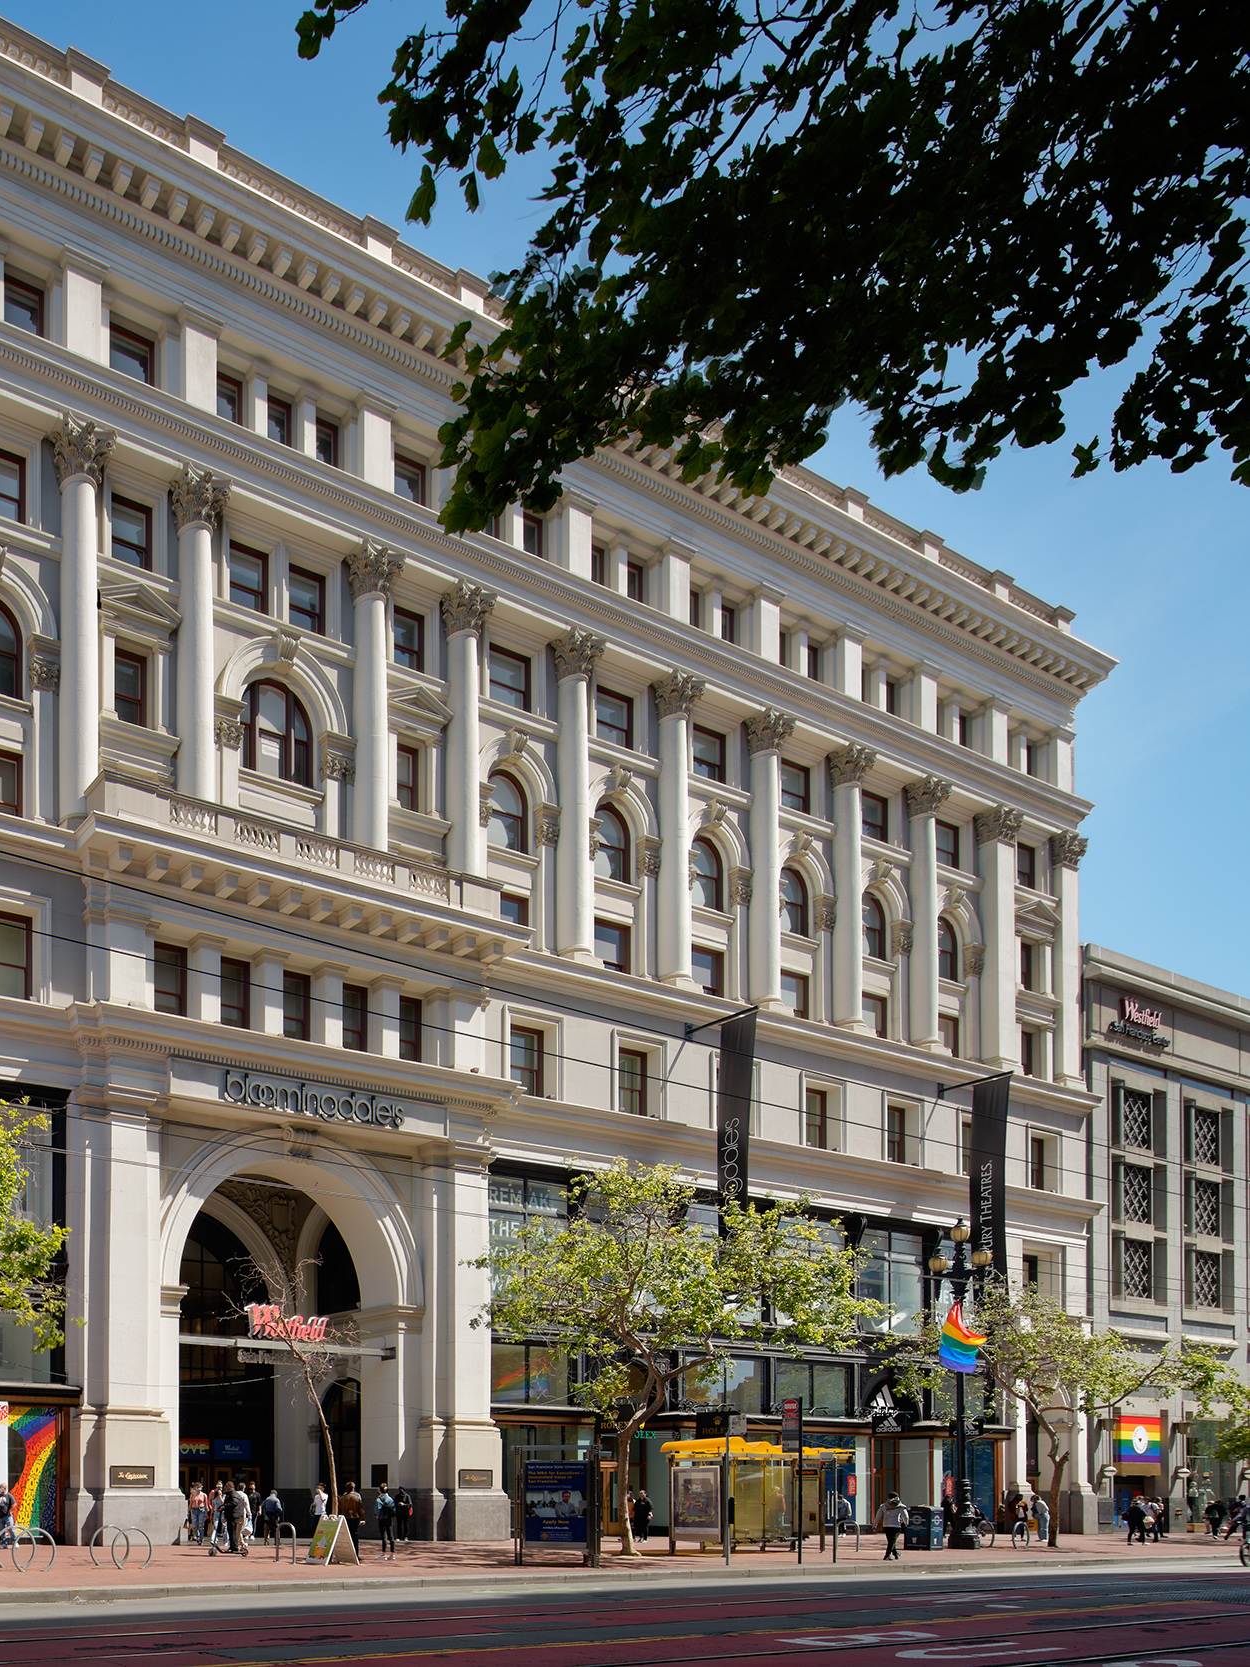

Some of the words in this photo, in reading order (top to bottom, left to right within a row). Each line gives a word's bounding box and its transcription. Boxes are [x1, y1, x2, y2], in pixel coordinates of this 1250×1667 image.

[1123, 996, 1162, 1029] Westfield
[875, 1424, 902, 1433] adidas
[953, 1428, 979, 1436] adas
[633, 1430, 656, 1440] OLEX
[180, 1443, 206, 1455] OVE
